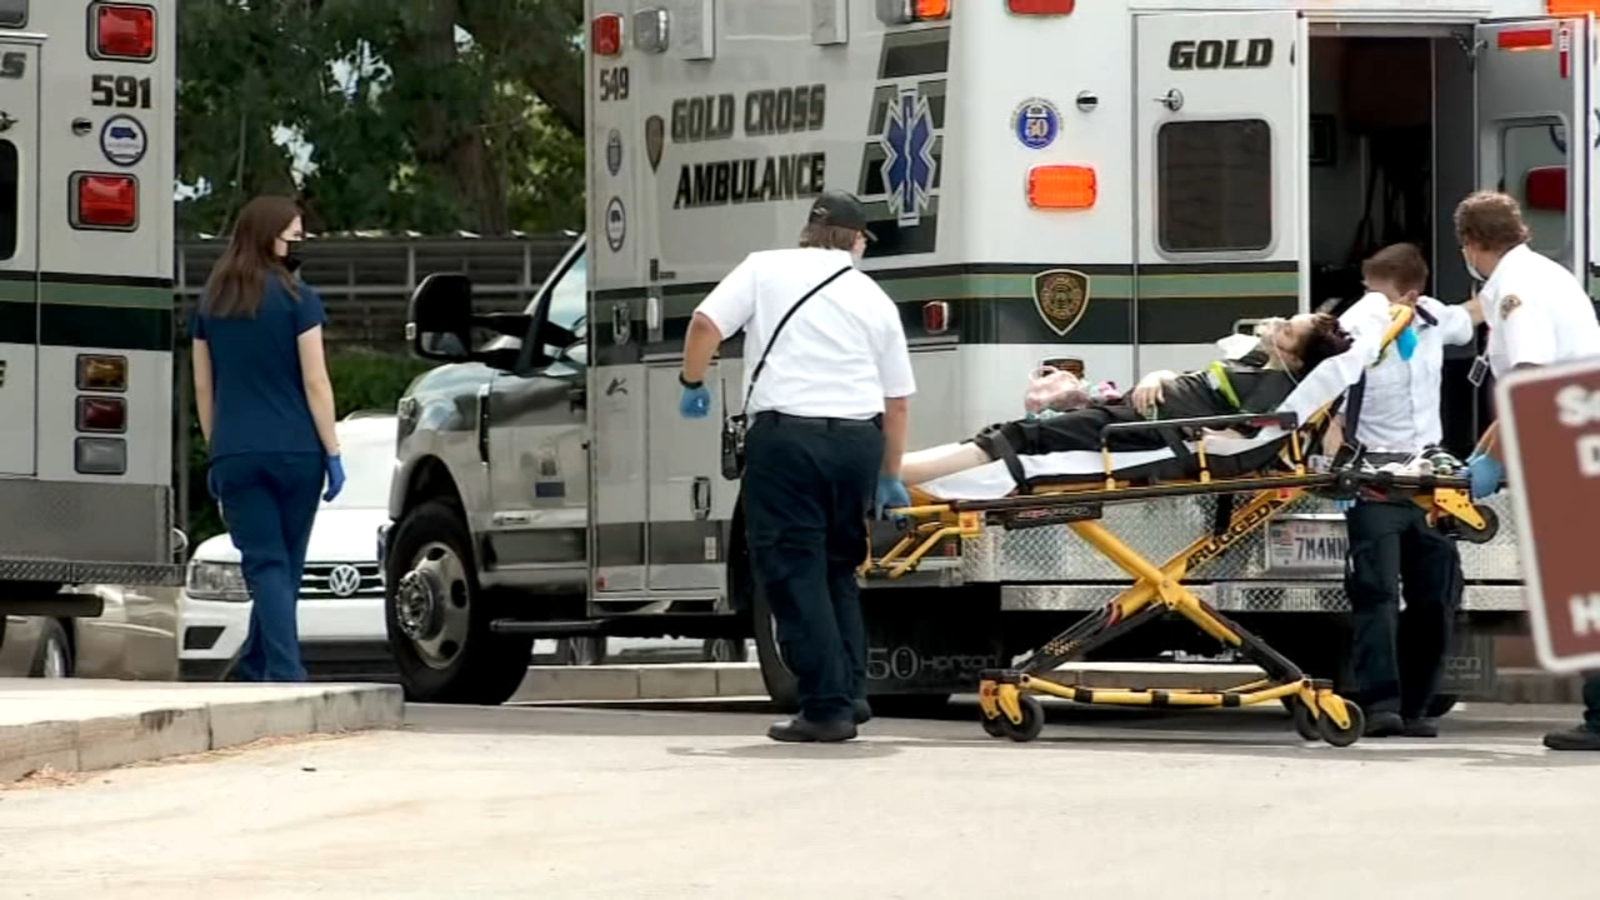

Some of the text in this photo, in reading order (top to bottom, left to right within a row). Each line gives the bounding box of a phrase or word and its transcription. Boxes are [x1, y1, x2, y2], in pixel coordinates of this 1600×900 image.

[1168, 38, 1274, 71] GOLD
[92, 74, 151, 109] 591
[600, 66, 629, 101] 549
[671, 83, 826, 144] GOLD CROSS
[1025, 118, 1049, 137] 50
[673, 151, 826, 210] AMBULANCE
[1190, 503, 1271, 562] RUGGED
